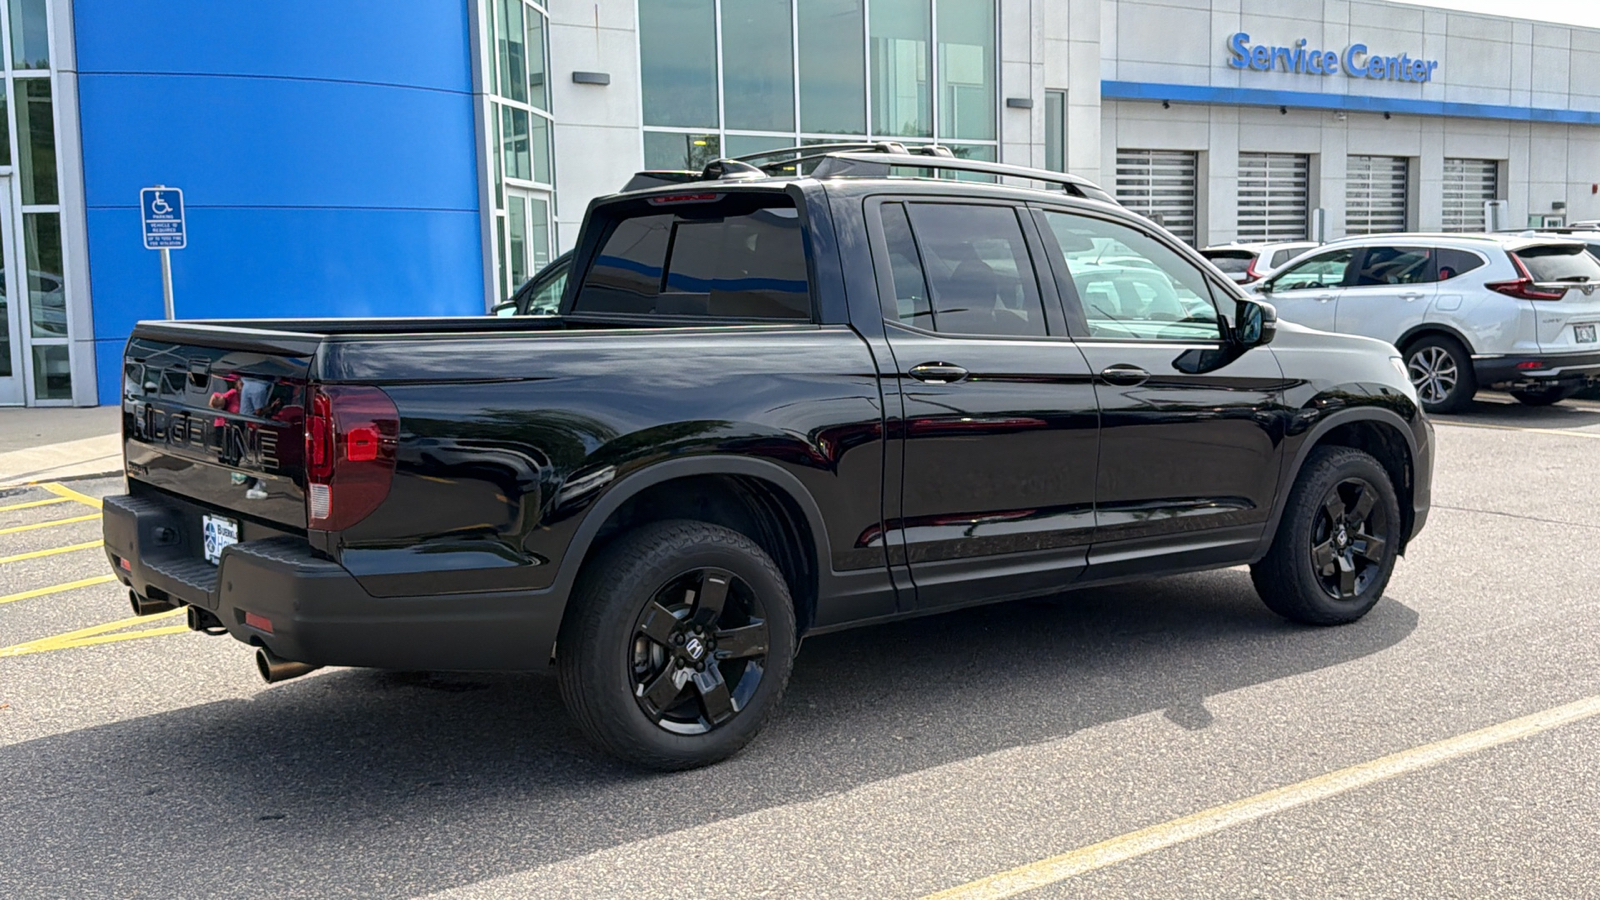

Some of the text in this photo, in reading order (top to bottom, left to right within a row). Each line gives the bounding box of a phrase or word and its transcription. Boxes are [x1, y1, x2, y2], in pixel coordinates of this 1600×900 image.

[1229, 32, 1438, 83] Service Center
[134, 404, 280, 471] RIDGELINE
